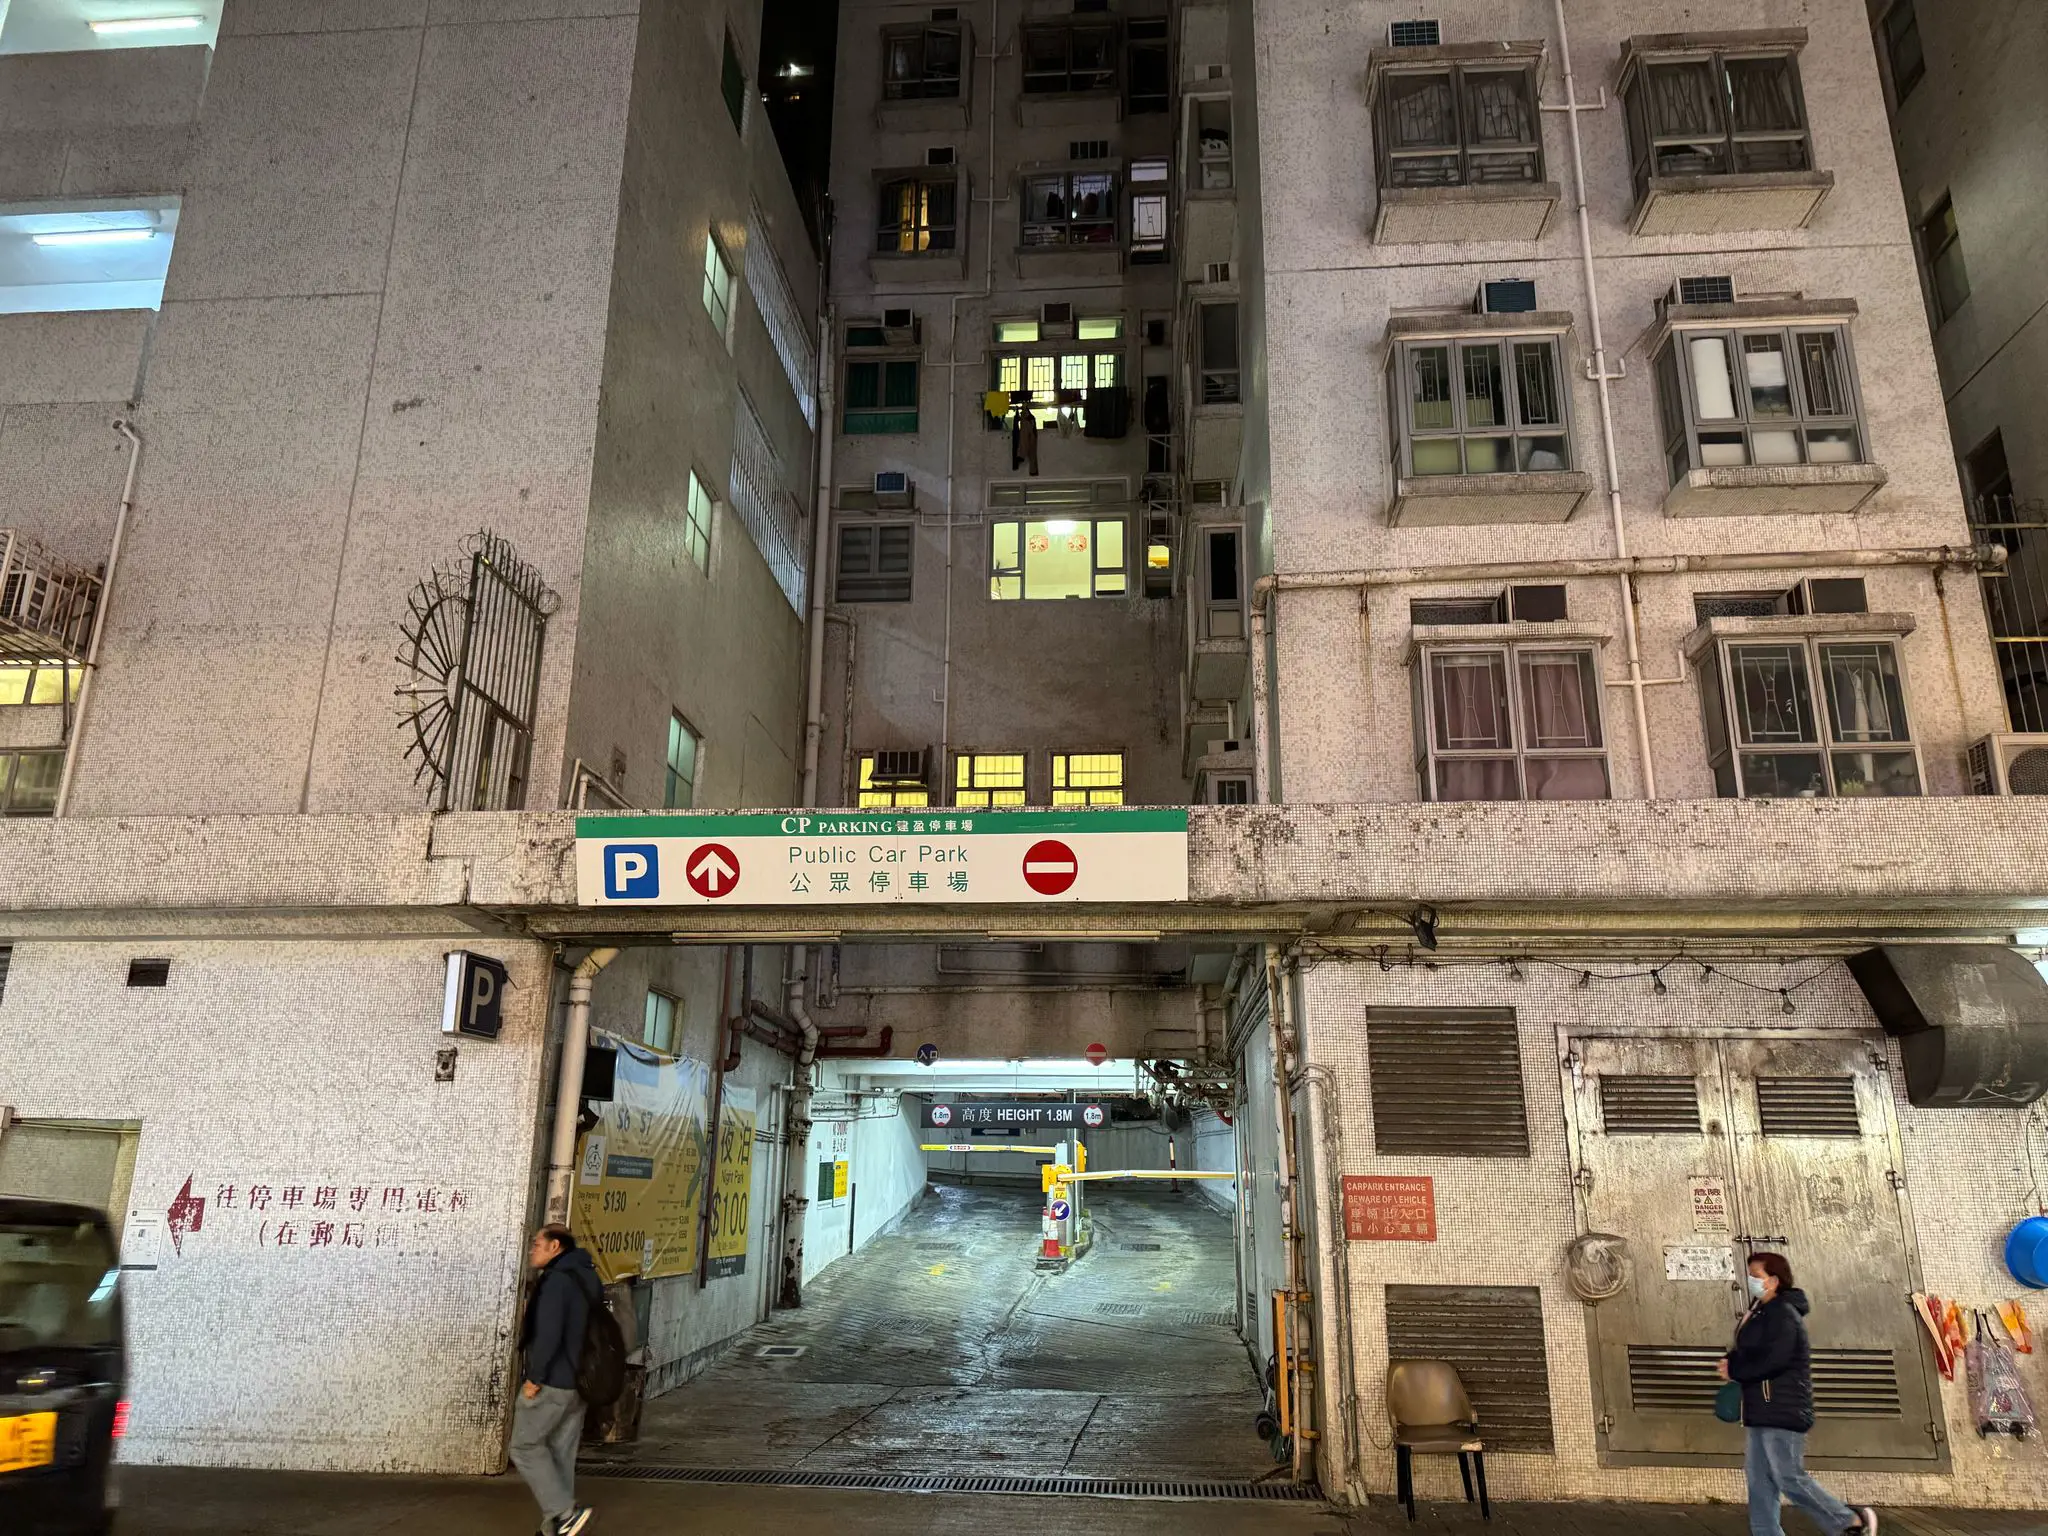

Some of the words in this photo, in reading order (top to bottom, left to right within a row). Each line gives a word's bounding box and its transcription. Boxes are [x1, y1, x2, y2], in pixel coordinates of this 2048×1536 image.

[781, 817, 811, 834] CP
[819, 821, 892, 834] PARKING
[789, 846, 856, 863] Public
[869, 845, 906, 863] Car
[919, 845, 968, 863] Park
[614, 852, 648, 892] P
[789, 870, 968, 893] 公眾停車場
[468, 966, 495, 1025] P
[919, 1049, 938, 1060] 入口
[933, 1111, 950, 1120] 1.8m
[961, 1107, 993, 1123] 高度
[997, 1108, 1042, 1121] HEIGHT
[1046, 1108, 1073, 1121] 1.8M
[1085, 1111, 1102, 1120] 1.8m
[1346, 1182, 1384, 1191] CARPARK
[1385, 1183, 1426, 1192] ENTRANCE
[603, 1189, 627, 1214] $130
[1348, 1194, 1381, 1204] BEWARE
[1382, 1195, 1393, 1204] OF
[710, 1186, 748, 1243] $100
[1351, 1207, 1426, 1220] 車輛出入口
[1351, 1222, 1428, 1235] 請小心車輛
[599, 1231, 622, 1253] $100
[623, 1229, 646, 1253] $100
